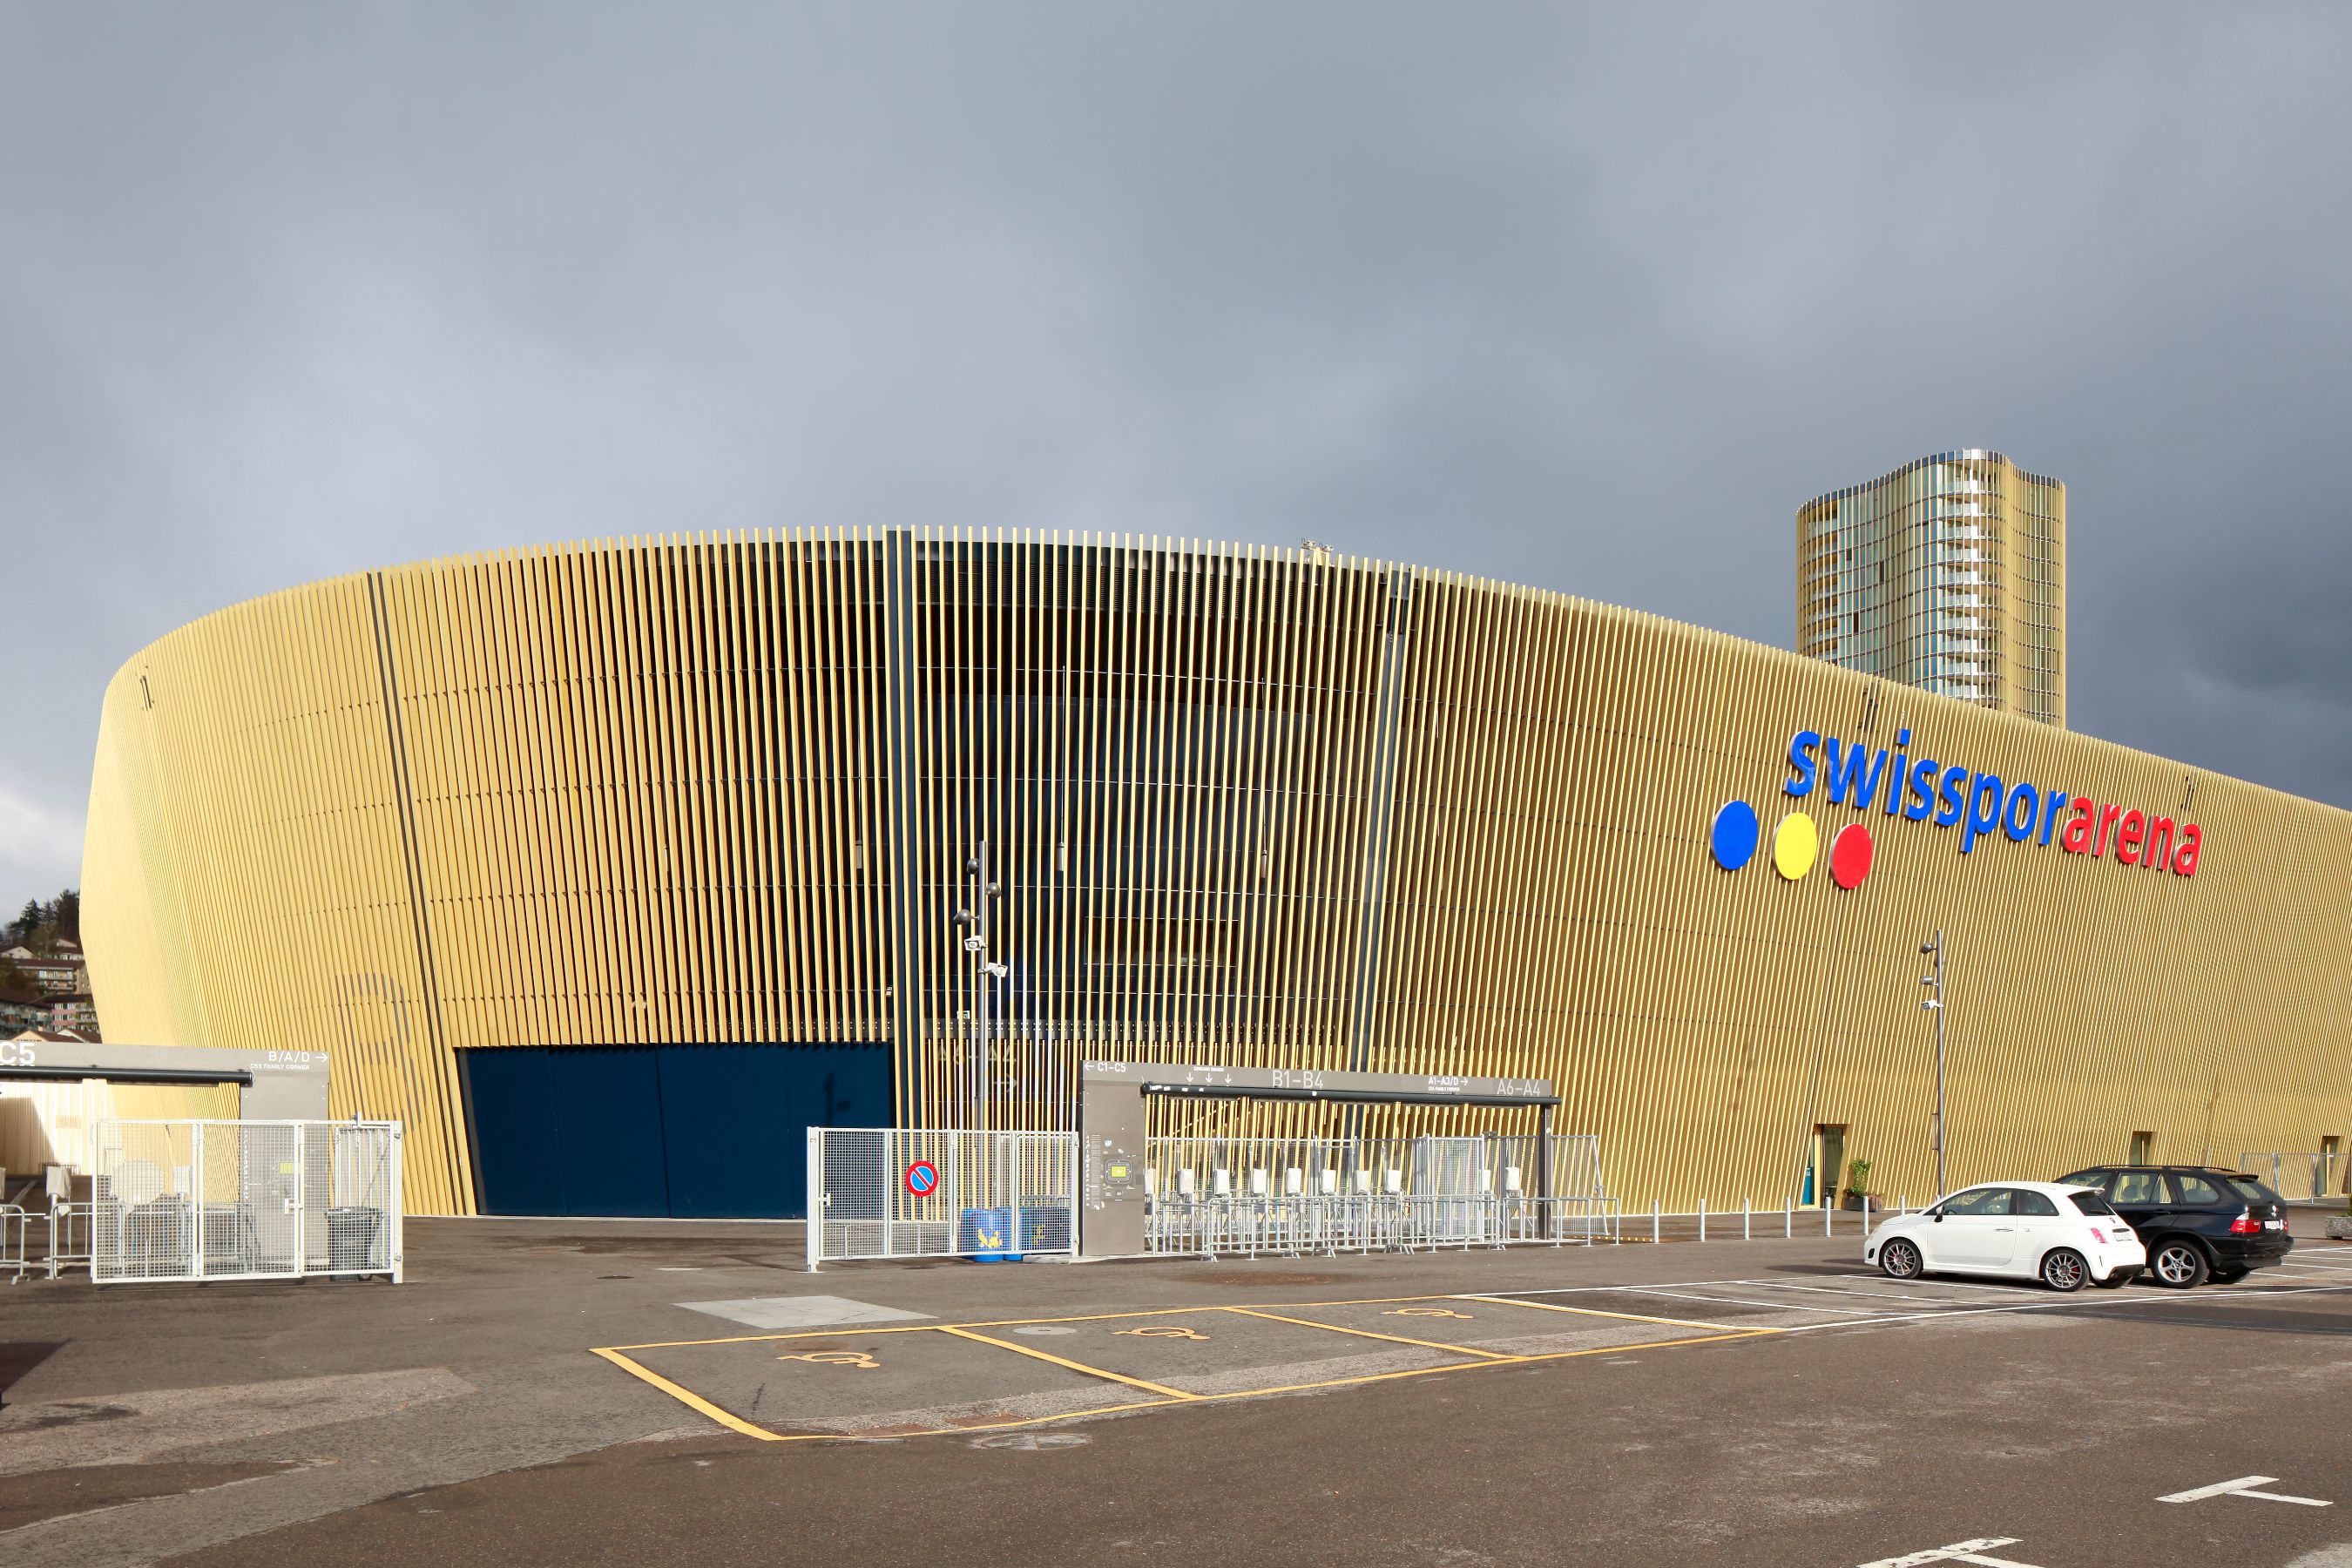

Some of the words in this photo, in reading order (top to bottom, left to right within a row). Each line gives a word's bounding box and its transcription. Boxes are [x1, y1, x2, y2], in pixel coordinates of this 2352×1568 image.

[1783, 728, 2202, 875] swissporarena
[0, 1042, 35, 1064] C5
[268, 1051, 310, 1063] B/A/D
[1097, 1062, 1126, 1072] C1-C5
[1272, 1070, 1324, 1089] B1-B4
[1429, 1076, 1459, 1086] A1-A3/D
[1497, 1078, 1541, 1097] A6-A4
